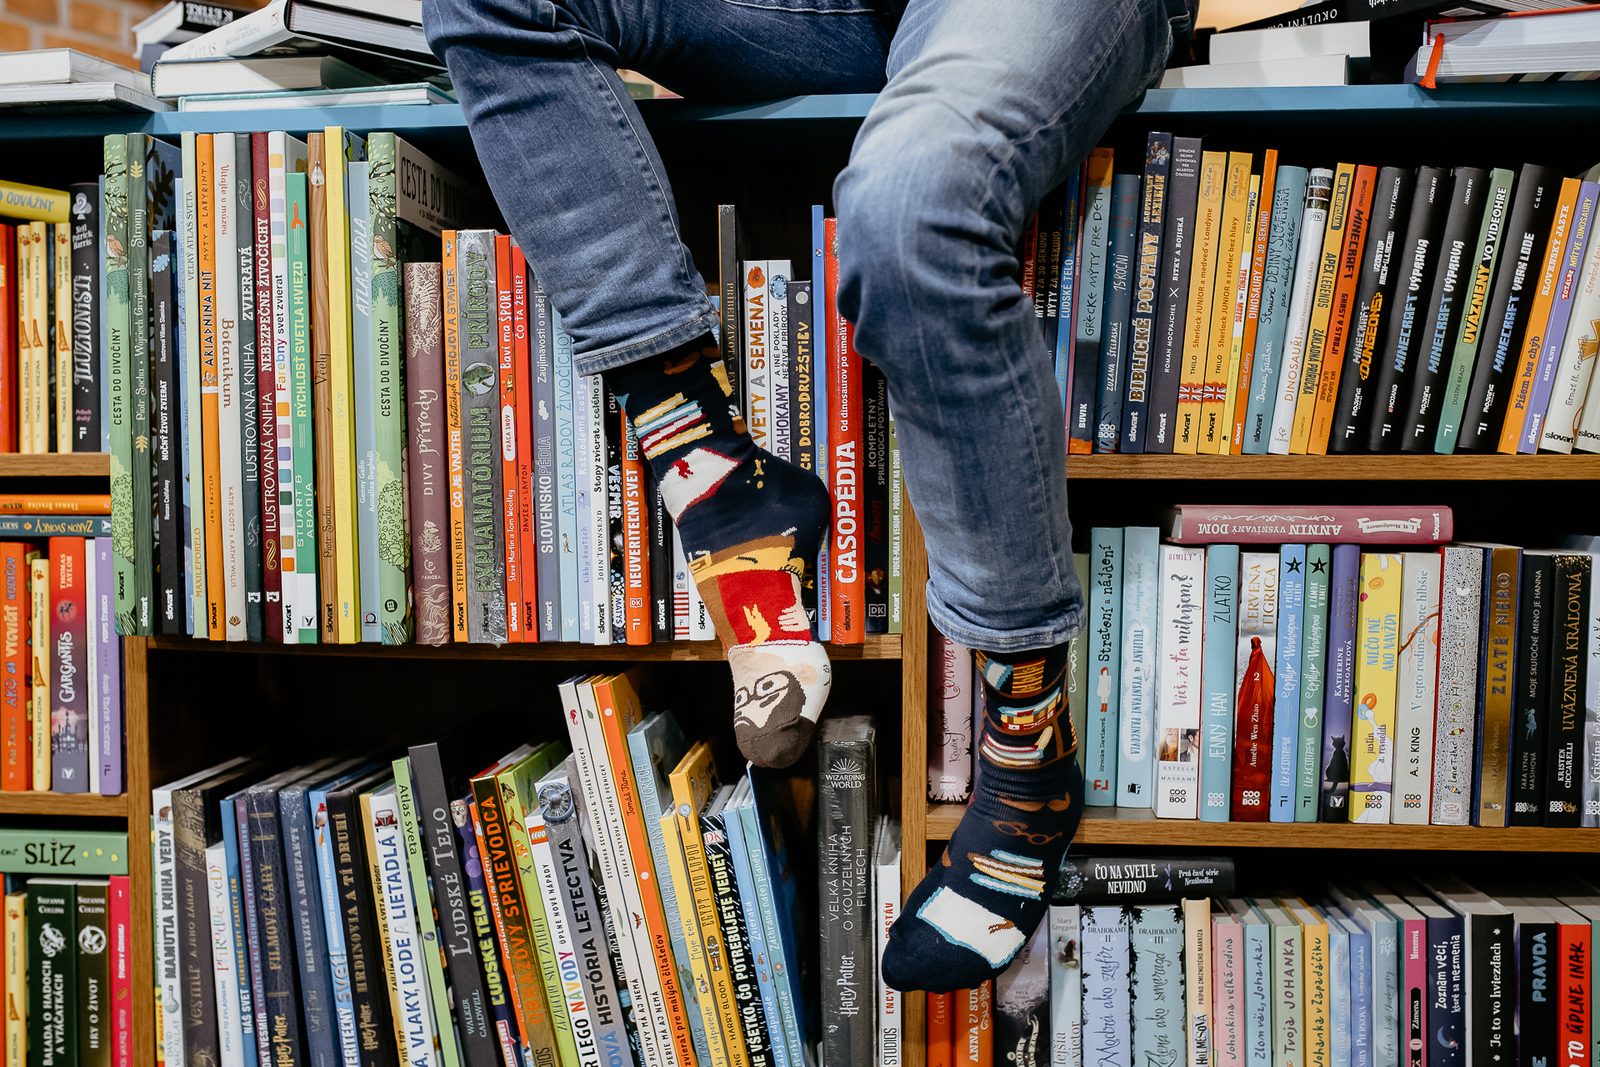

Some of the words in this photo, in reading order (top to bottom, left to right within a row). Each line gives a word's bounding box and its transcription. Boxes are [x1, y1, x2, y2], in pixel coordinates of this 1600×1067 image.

[130, 208, 146, 247] Stromy
[1174, 217, 1184, 248] BOJISKÁ
[1230, 216, 1238, 237] hlavy
[1255, 211, 1268, 241] SEKÚND
[1486, 187, 1507, 242] VIDEOHRE
[1574, 197, 1592, 239] DINOSAURY
[254, 217, 269, 289] ŽIVOČÍCHY
[1225, 252, 1234, 279] strelec
[1255, 256, 1264, 267] ZA
[1256, 243, 1265, 254] 30
[1323, 253, 1337, 276] APEX
[1482, 245, 1494, 261] VO
[1541, 240, 1560, 296] SLOVENSKÝ
[1553, 205, 1570, 237] JAZYK
[238, 246, 253, 321] ZVIERATÁ
[293, 261, 304, 304] HVIEZD
[1136, 232, 1159, 313] POSTAVY
[1172, 258, 1181, 281] BITKY
[274, 274, 284, 310] zvierat
[463, 250, 489, 350] PRÍRODY
[497, 290, 511, 321] ŠPORT
[513, 275, 525, 305] ŽERIE?
[1221, 286, 1230, 314] JUNIOR
[1248, 269, 1262, 318] DINOSAURY
[1317, 277, 1332, 308] LEGENDS
[1428, 294, 1453, 373] MINECRAFT
[1442, 240, 1464, 292] VÝPRAVA
[1462, 264, 1490, 344] UVÄZNENÝ
[256, 291, 271, 372] NEBEZPEČNÉ
[275, 313, 285, 334] svet
[293, 308, 305, 353] SVETLA
[503, 325, 511, 342] ma
[514, 308, 525, 321] ŤA
[515, 324, 525, 339] ČO
[746, 294, 765, 370] SEMENÁ
[1219, 315, 1228, 348] Sherlock
[110, 328, 121, 374] DIVOČINY
[219, 318, 234, 408] Botanikum
[242, 342, 256, 385] KNIHA
[275, 338, 287, 391] Farebný
[500, 346, 511, 369] Baví
[1129, 318, 1151, 402] BIBLICKÉ
[1524, 335, 1540, 359] chýb
[112, 378, 121, 391] DO
[293, 356, 306, 417] RÝCHLOSŤ
[315, 353, 330, 385] Včely
[752, 375, 765, 388] A
[1521, 361, 1534, 378] bez
[112, 395, 122, 426] CESTA
[159, 380, 168, 409] ZVIERAT
[1514, 379, 1530, 410] Píšem
[158, 410, 168, 433] ŽIVOT
[261, 393, 274, 437] KNIHA
[416, 389, 439, 455] přírody
[1079, 403, 1087, 428] BUVIK
[158, 433, 169, 460] NOČNÝ
[241, 389, 258, 482] ILUSTROVANÁ
[260, 440, 276, 532] ILUSTROVANÁ
[423, 463, 434, 496] DIVY
[535, 436, 553, 553] SLOVENSKOPÉDIA
[626, 470, 639, 497] SVET
[467, 407, 496, 592] EXPLANATÓRIUM
[835, 441, 857, 583] ČASOPÉDIA
[627, 500, 642, 588] NEUVERITEĽNÝ
[1198, 523, 1228, 534] DOM
[1231, 525, 1286, 534] VYSNÍVANÝ
[1289, 524, 1342, 536] ANNIN
[192, 527, 202, 597] MAXILEPORELO
[1098, 543, 1114, 594] nájdení
[1213, 575, 1231, 623] ZLATKO
[1262, 568, 1276, 627] TIGRICA
[1534, 570, 1542, 599] HANNA
[1532, 610, 1540, 633] MENO
[1563, 572, 1582, 650] KRÁĽOVNÁ
[1097, 607, 1114, 661] Stratení
[1334, 647, 1344, 697] KATHERINE
[1342, 640, 1352, 704] APPLEGATEOVÁ
[1529, 635, 1539, 675] SKUTOČNÉ
[1211, 693, 1227, 716] HAN
[1529, 678, 1537, 697] MOJE
[1561, 653, 1578, 731] UVÄZNENÁ
[1252, 704, 1260, 722] Zhao
[1209, 724, 1227, 761] JENNY
[1251, 724, 1259, 741] Wen
[1410, 727, 1420, 753] KING
[1249, 742, 1258, 768] Amélie
[1410, 756, 1419, 764] S.
[1410, 767, 1419, 777] A.
[159, 830, 171, 864] VEDY
[432, 808, 454, 866] TELO
[828, 834, 838, 874] KNIHA
[480, 796, 519, 918] SPRIEVODCA
[708, 853, 732, 895] VEDIEŤ
[840, 825, 852, 916] KOUZELNÝCH
[1095, 864, 1107, 879] ČO
[1110, 866, 1122, 879] NA
[1125, 864, 1158, 878] SVETLE
[160, 868, 174, 910] KNIHA
[381, 835, 407, 919] LIETADLÁ
[558, 838, 592, 933] LETECTVA
[856, 848, 866, 907] FILMECH
[1108, 881, 1146, 894] NEVIDNO
[469, 889, 493, 935] TELO!
[829, 879, 839, 922] VELKÁ
[721, 896, 748, 980] POTREBUJETE
[842, 921, 853, 930] O
[162, 914, 177, 979] MAMUTIA
[396, 938, 416, 984] LODE
[1433, 941, 1448, 968] vecí,
[1569, 941, 1583, 979] INAK
[42, 961, 52, 1009] HADOCH
[558, 951, 586, 1012] NÁVODY
[581, 938, 613, 1025] HISTÓRIA
[1284, 938, 1295, 1009] JOHANKA
[1490, 943, 1501, 997] hviezdach
[1533, 932, 1546, 1002] PRAVDA
[87, 978, 98, 1011] ŽIVOT
[735, 984, 752, 1000] ČO
[1435, 972, 1447, 1009] Zoznam
[1493, 1001, 1501, 1014] vo
[1566, 984, 1583, 1034] ÚPLNE
[43, 1013, 52, 1021] O
[89, 1014, 98, 1023] O
[406, 988, 426, 1048] VLAKY,
[743, 1002, 765, 1052] VŠETKO,
[1283, 1017, 1297, 1054] Tvoja
[1492, 1018, 1501, 1030] to
[43, 1025, 53, 1066] BALADA
[56, 1046, 64, 1054] A
[89, 1027, 99, 1048] HRY
[1491, 1034, 1501, 1047] Je
